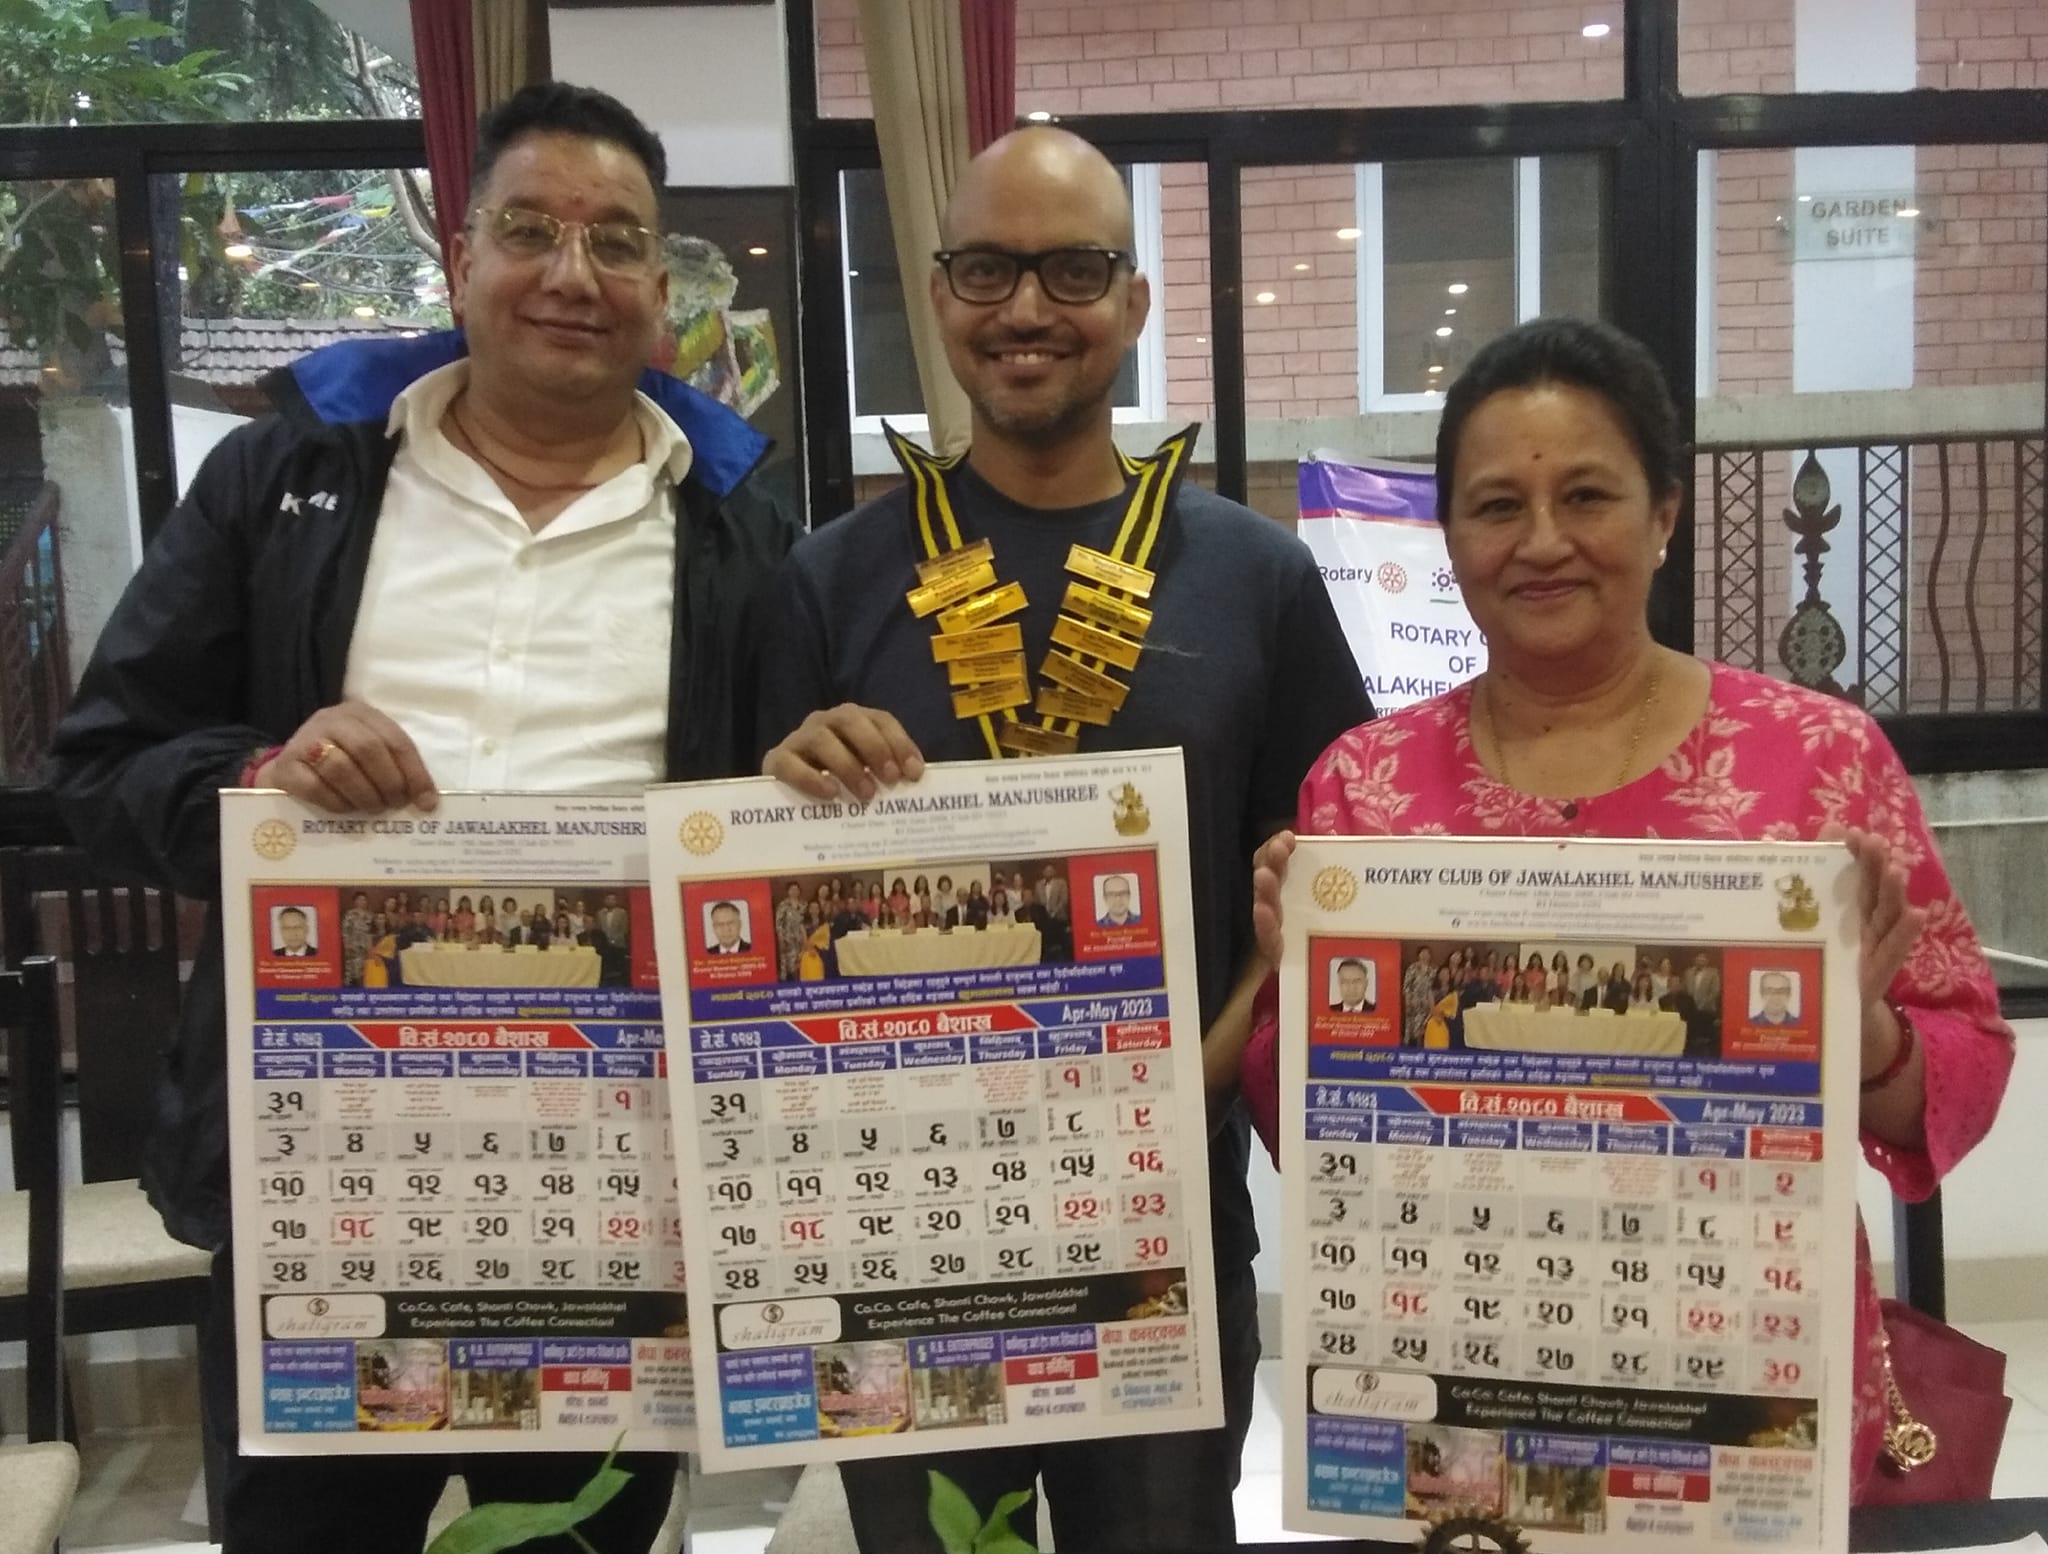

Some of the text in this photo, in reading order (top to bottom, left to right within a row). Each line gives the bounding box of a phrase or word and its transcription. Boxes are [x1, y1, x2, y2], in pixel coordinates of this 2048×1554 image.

[1827, 228, 1889, 247] SUITE
[1318, 566, 1372, 583] Rotary
[1390, 622, 1472, 647] ROTARY
[1449, 655, 1476, 673] OF
[730, 784, 1099, 825] ROTARY CLUB OF JAWALAKHEL MANJUSHREE
[302, 819, 647, 836] ROTARY CLUB OF JAWALAKHEL MANJUSHR
[1365, 866, 1764, 891] ROTARY CLUB OF JAWALAKHEL MANJUSHREE
[1062, 999, 1152, 1025] Apr-May 2023
[1054, 1043, 1087, 1055] Friday
[1116, 1037, 1162, 1050] Saturday
[903, 1053, 964, 1066] Wednesday
[978, 1048, 1026, 1061] Thursday
[774, 1064, 817, 1075] Monday
[843, 1059, 886, 1070] Tuesday
[707, 1069, 746, 1081] Sunday
[1702, 1101, 1805, 1124] Apr-May 2023
[934, 1295, 972, 1308] Shanti
[974, 1290, 1019, 1305] Chowk,
[1021, 1286, 1089, 1302] Jawalakhel
[411, 1318, 475, 1329] Experience
[480, 1316, 500, 1327] The
[503, 1316, 545, 1328] Coffee
[868, 1316, 935, 1330] Experience
[938, 1312, 959, 1324] The
[962, 1307, 1005, 1322] Coffee
